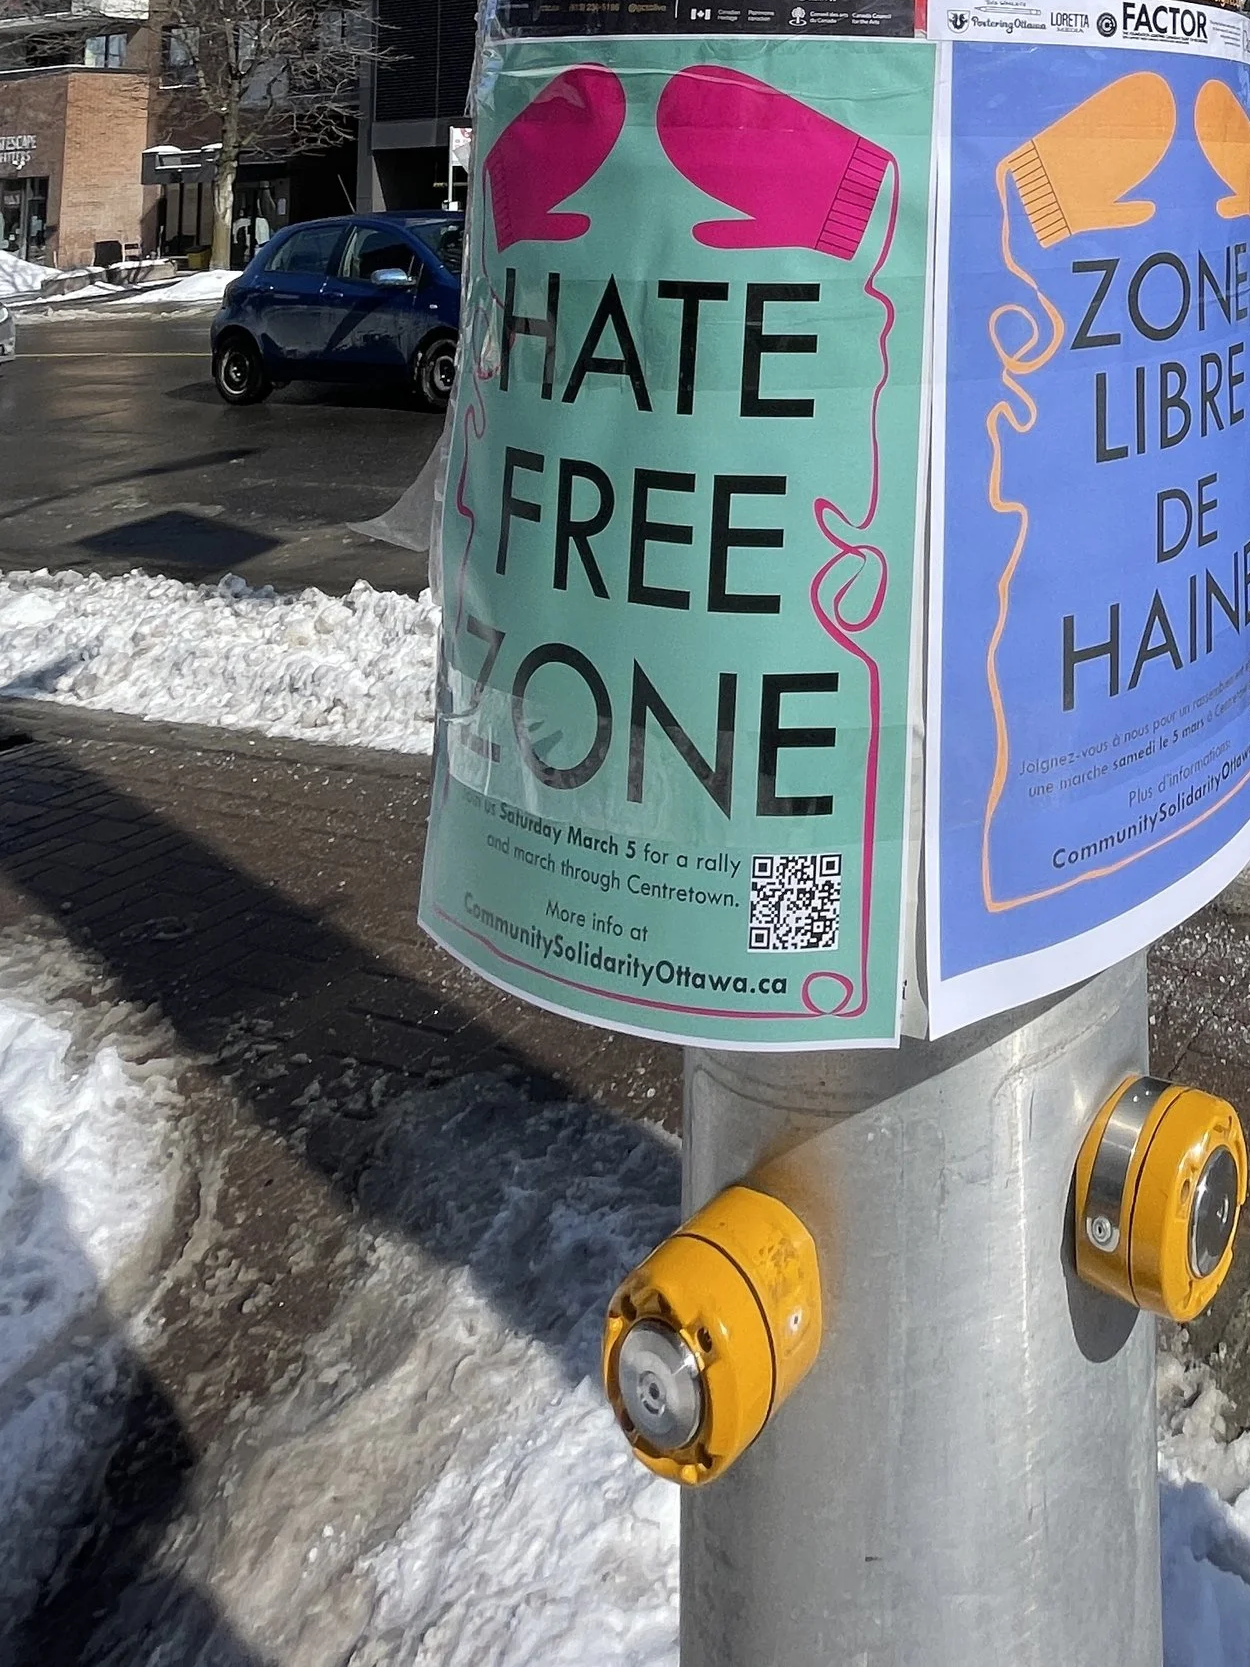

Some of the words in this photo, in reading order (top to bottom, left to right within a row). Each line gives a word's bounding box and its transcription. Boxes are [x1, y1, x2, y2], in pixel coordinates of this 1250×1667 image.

[1050, 12, 1090, 28] LORETTA
[1122, 2, 1208, 39] FACTOR
[1071, 242, 1247, 350] ZONE
[500, 268, 821, 418] HATE
[1095, 342, 1245, 463] LIBRE
[496, 446, 788, 615] FREE
[1156, 472, 1218, 564] DE
[458, 616, 840, 821] ZONE
[1019, 741, 1109, 777] Joignez-vous
[1112, 733, 1121, 748] à
[1123, 723, 1150, 744] nous
[1152, 710, 1176, 734] pour
[1179, 704, 1190, 717] un
[1028, 783, 1053, 798] une
[1059, 764, 1108, 790] marche
[1113, 741, 1156, 771] samedi
[1159, 735, 1169, 751] le
[1172, 730, 1180, 744] 5
[1182, 719, 1205, 739] mars
[1128, 790, 1153, 808] Plus
[487, 833, 511, 855] and
[514, 845, 556, 874] march
[561, 859, 621, 893] through
[627, 874, 740, 908] Centretown.
[499, 802, 562, 845] Saturday
[567, 826, 619, 857] March
[625, 840, 636, 860] 5
[643, 844, 671, 867] for
[676, 851, 688, 868] a
[696, 854, 742, 879] rally
[463, 891, 788, 995] CommunitySolidarityOttawa.ca
[545, 900, 586, 927] More
[592, 912, 624, 937] info
[629, 925, 649, 942] at
